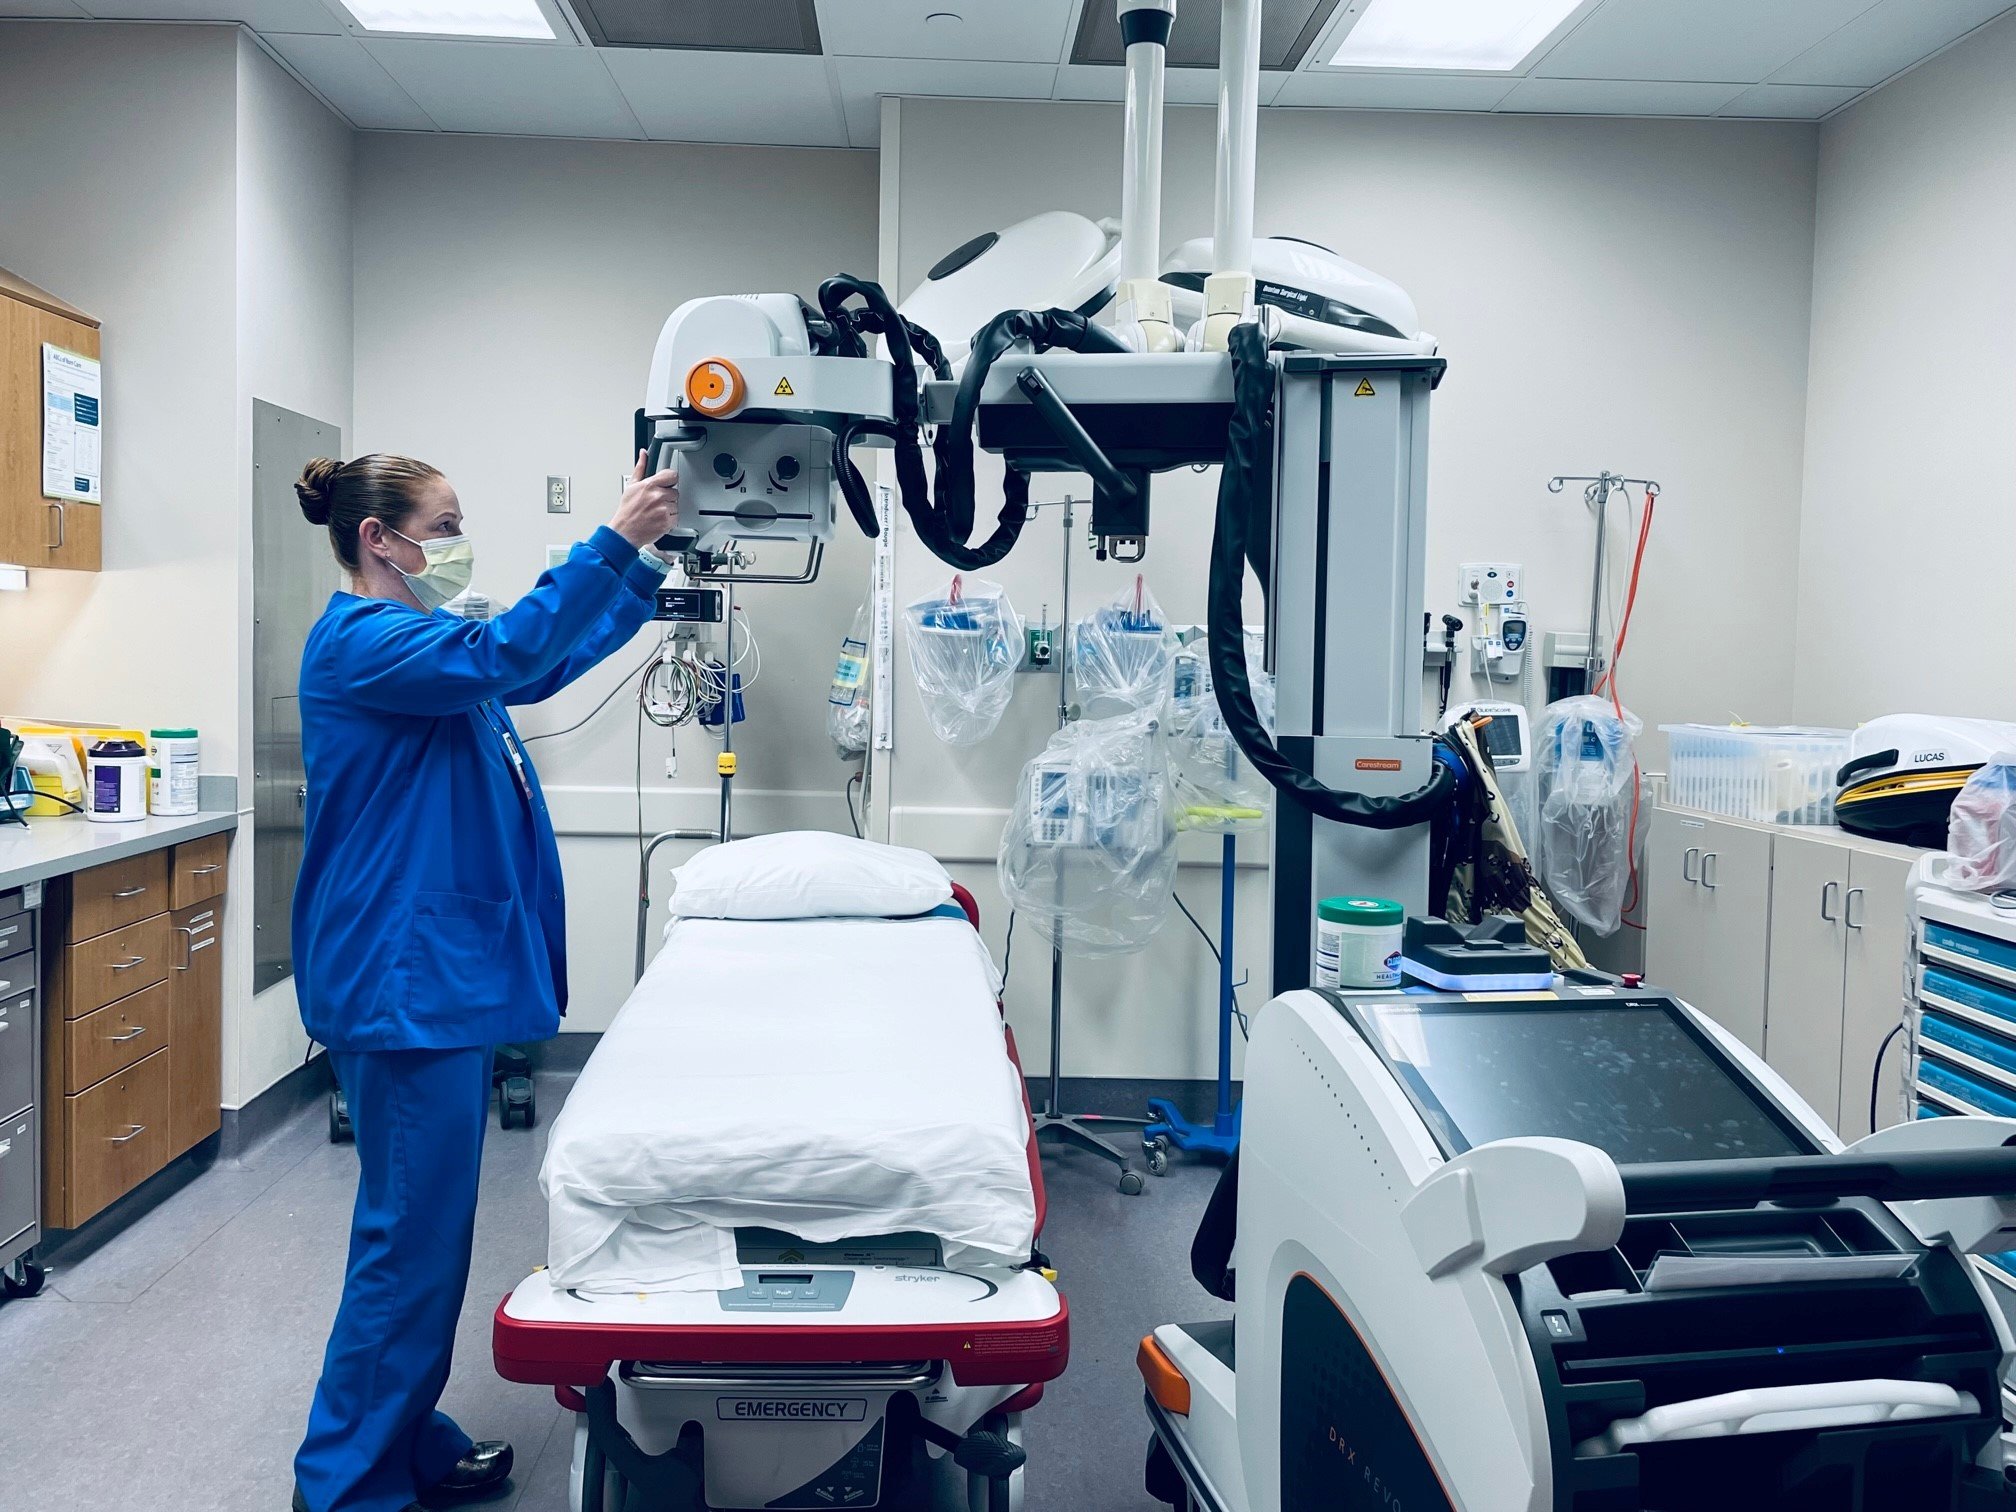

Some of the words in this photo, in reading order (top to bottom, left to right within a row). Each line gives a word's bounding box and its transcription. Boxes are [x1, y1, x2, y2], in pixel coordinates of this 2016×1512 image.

[1914, 752, 1945, 763] LUCAS
[1356, 761, 1400, 769] Carestream
[894, 1274, 941, 1283] stryker
[735, 1401, 849, 1417] EMERGENCY
[1329, 1425, 1356, 1466] DRX
